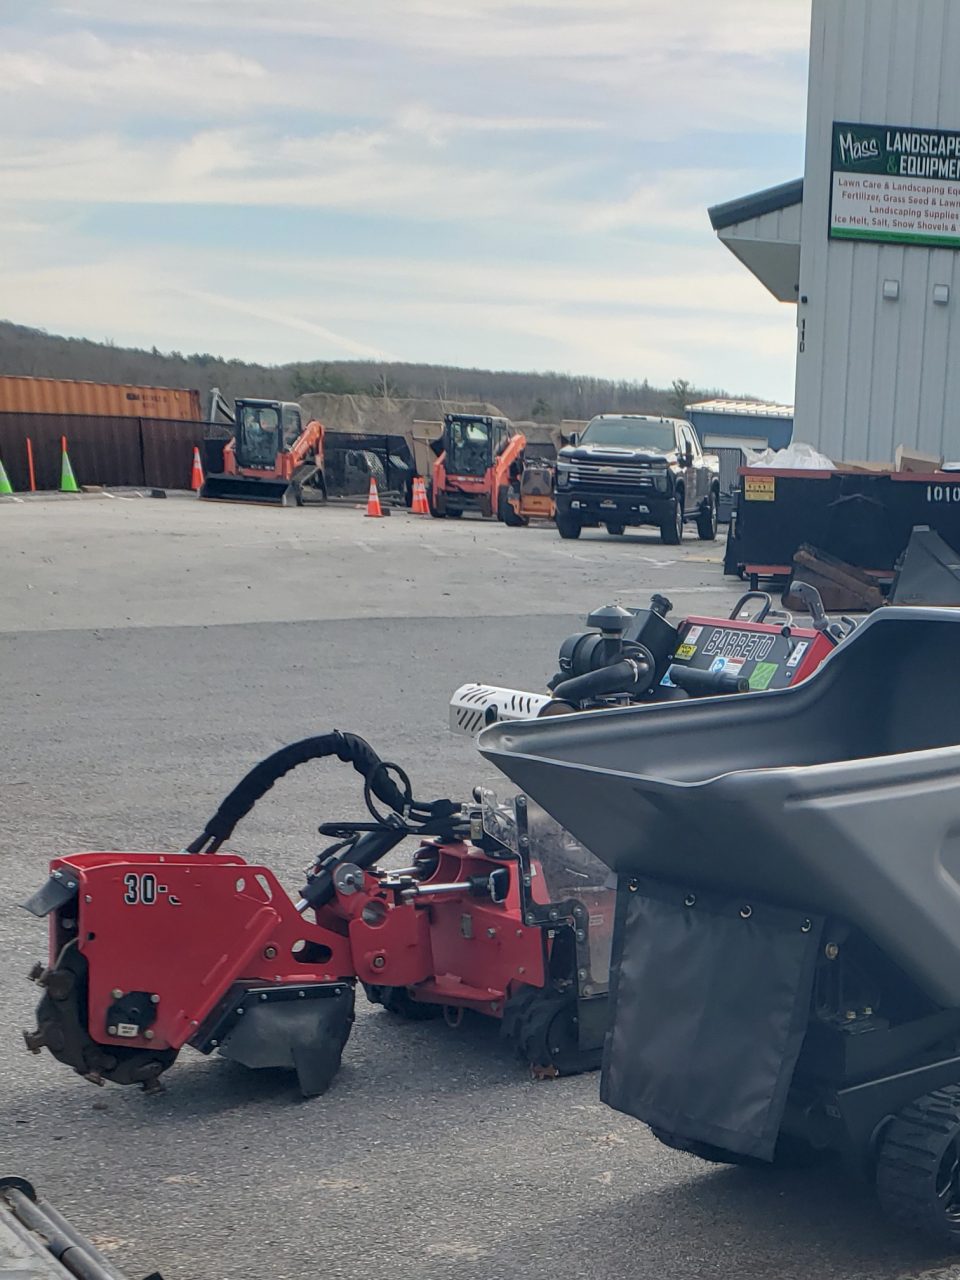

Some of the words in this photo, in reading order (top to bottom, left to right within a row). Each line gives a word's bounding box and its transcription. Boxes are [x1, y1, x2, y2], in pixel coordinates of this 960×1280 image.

[839, 132, 879, 161] Mass
[838, 177, 861, 188] Lawn
[862, 180, 882, 190] Care
[892, 182, 945, 196] Landscaping
[841, 191, 881, 203] Fertilizer,
[883, 194, 906, 204] Grass
[908, 196, 929, 206] Seed
[939, 199, 960, 208] Lawn
[869, 205, 922, 219] Landscaping
[924, 209, 960, 222] Supplies
[834, 214, 847, 224] Ice
[849, 216, 870, 227] Melt,
[871, 218, 890, 229] Salt,
[892, 220, 915, 230] Snow
[917, 221, 949, 233] Shovels
[702, 629, 775, 661] BARRETO
